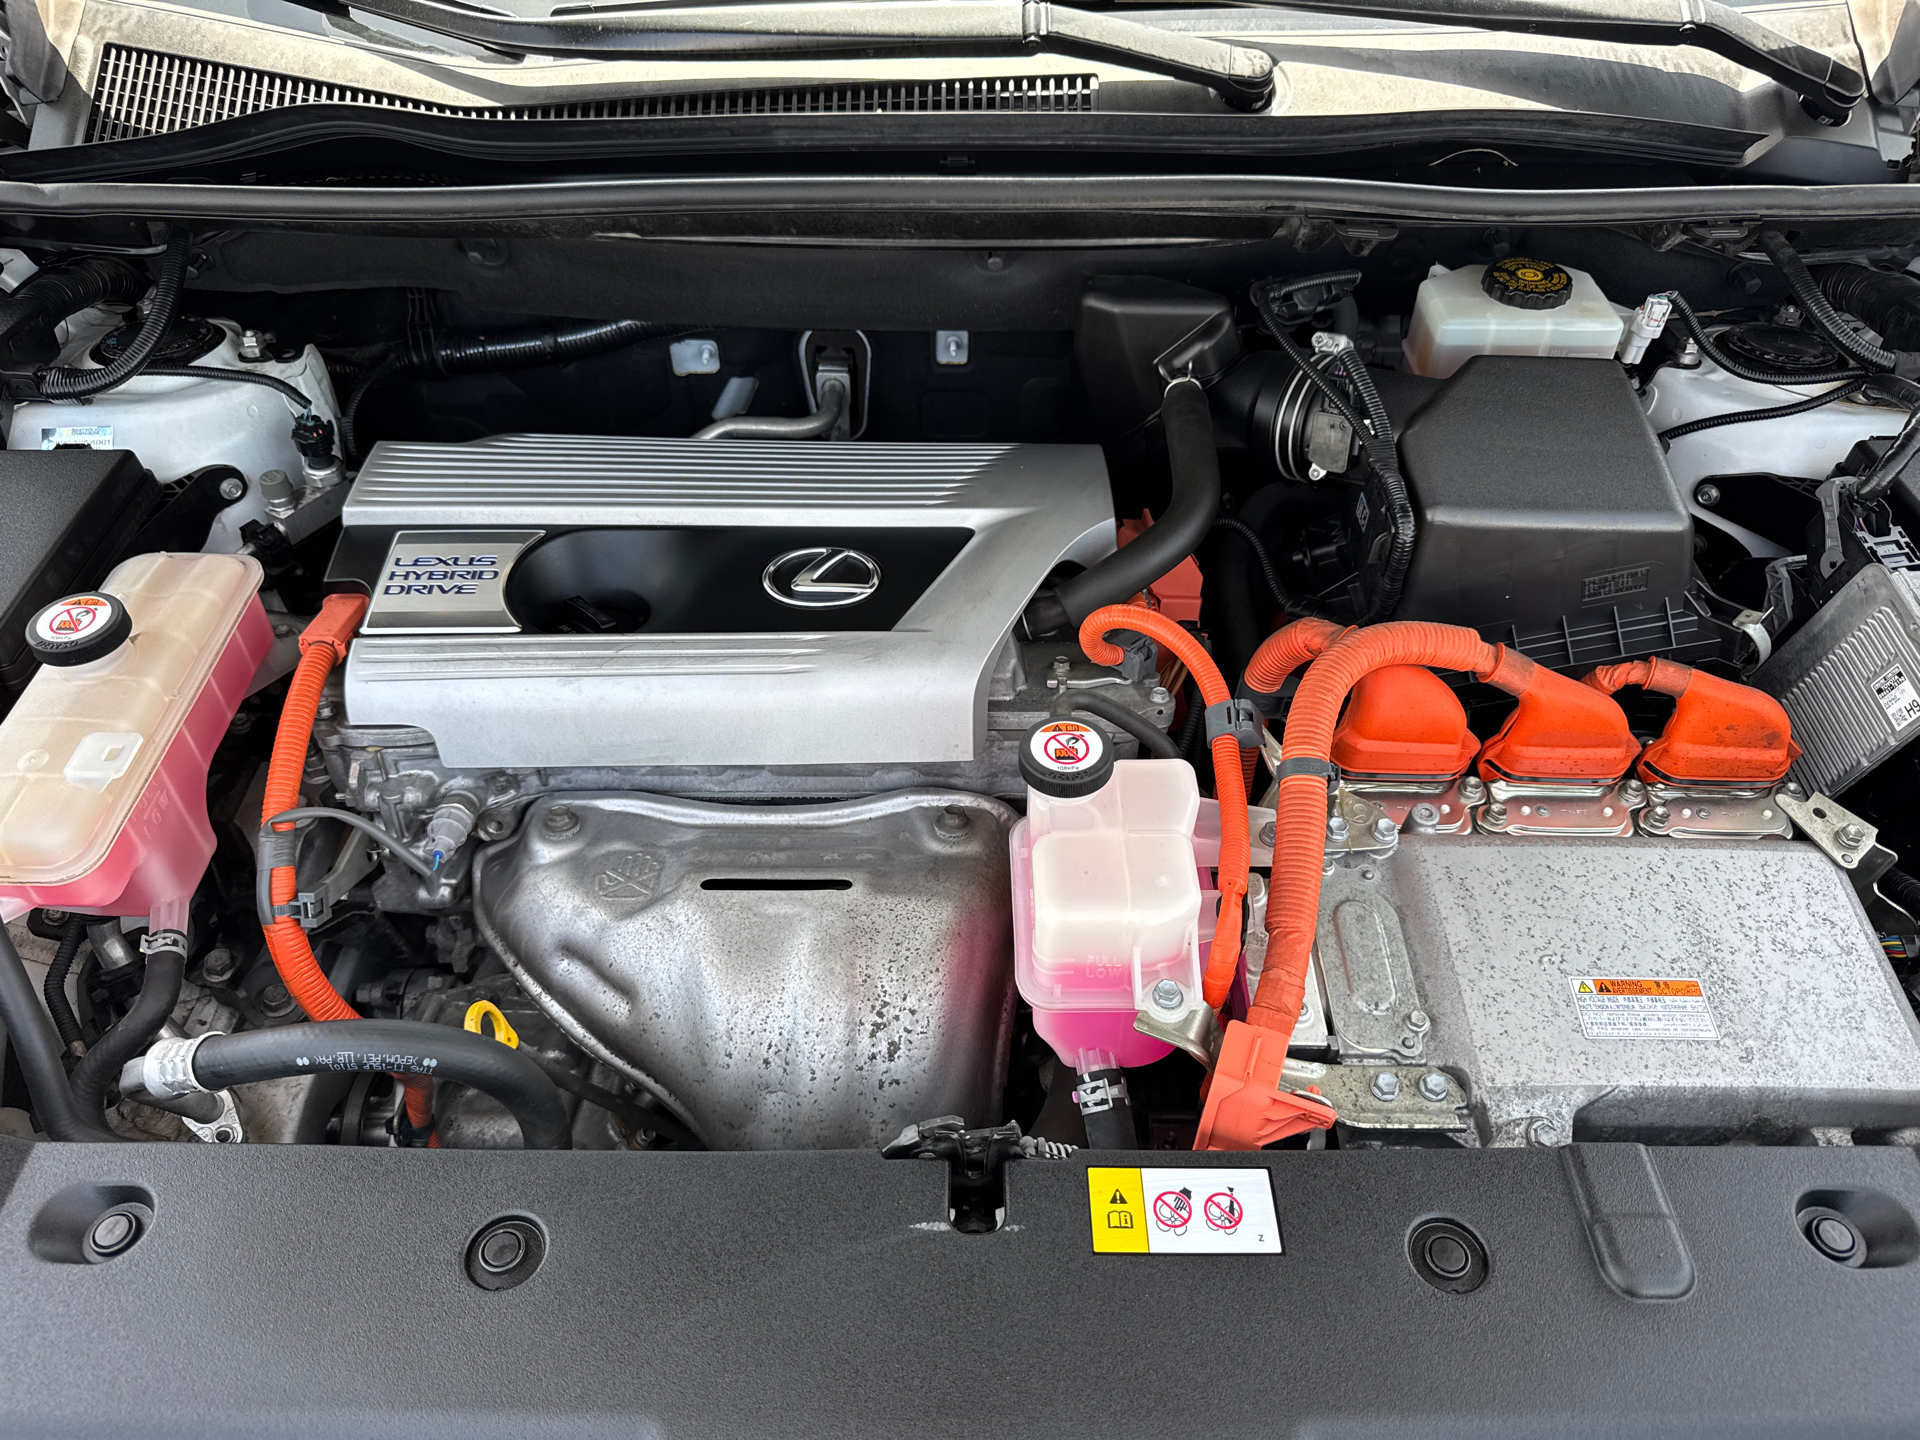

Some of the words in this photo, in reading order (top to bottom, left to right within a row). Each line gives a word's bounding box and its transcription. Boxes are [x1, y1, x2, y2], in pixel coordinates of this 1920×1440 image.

[394, 555, 498, 567] LEXUS
[388, 568, 500, 581] HYBRID
[383, 582, 479, 595] DRIVE
[34, 640, 79, 650] DENSO
[1881, 675, 1898, 690] TOYOTA
[1086, 954, 1122, 967] FULL
[1085, 967, 1122, 979] LOW
[1610, 980, 1643, 988] WARNING
[1612, 987, 1652, 995] AVERTISSEMENT
